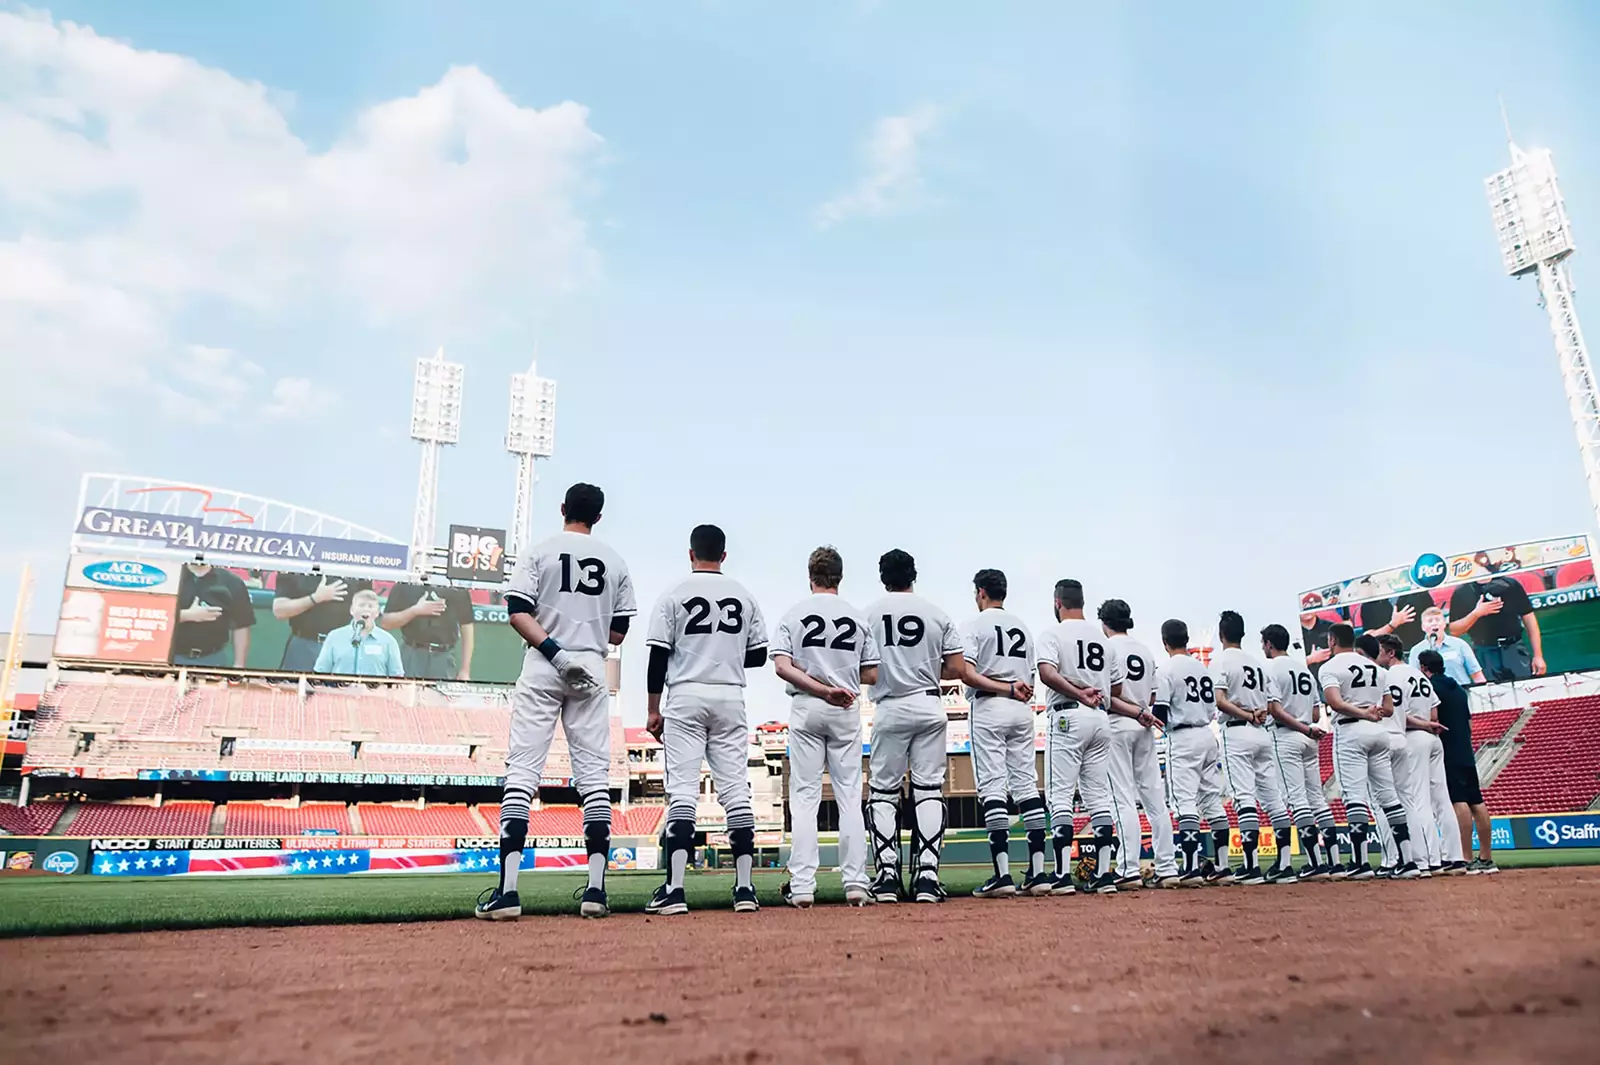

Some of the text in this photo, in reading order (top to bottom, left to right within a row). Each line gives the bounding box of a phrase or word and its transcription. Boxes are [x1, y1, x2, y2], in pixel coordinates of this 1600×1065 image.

[453, 533, 499, 556] BIG
[321, 551, 402, 567] INSURANCE GROUP
[1417, 562, 1444, 579] P&G
[1452, 561, 1473, 577] Tide
[558, 553, 607, 595] 13
[474, 611, 508, 622] S.CO
[682, 596, 743, 635] 23
[800, 614, 857, 652] 22
[882, 614, 925, 647] 19
[994, 625, 1026, 658] 12
[1077, 640, 1104, 671] 18
[1126, 654, 1145, 681] 9
[1242, 666, 1264, 692] 31
[1348, 665, 1377, 688] 27
[1184, 676, 1214, 703] 38
[1289, 670, 1312, 696] 16
[1408, 676, 1431, 698] 26
[230, 771, 497, 786] O'ER THE LAND OF THE FREE AND THE HOME OF THE BRAVE
[91, 838, 281, 850] NOCO START DEAD BATTERIES.
[285, 838, 452, 849] ULTRASAFE LITHIUM JUMP STARTERS.
[536, 838, 560, 848] DEAD
[561, 838, 587, 848] BATTE
